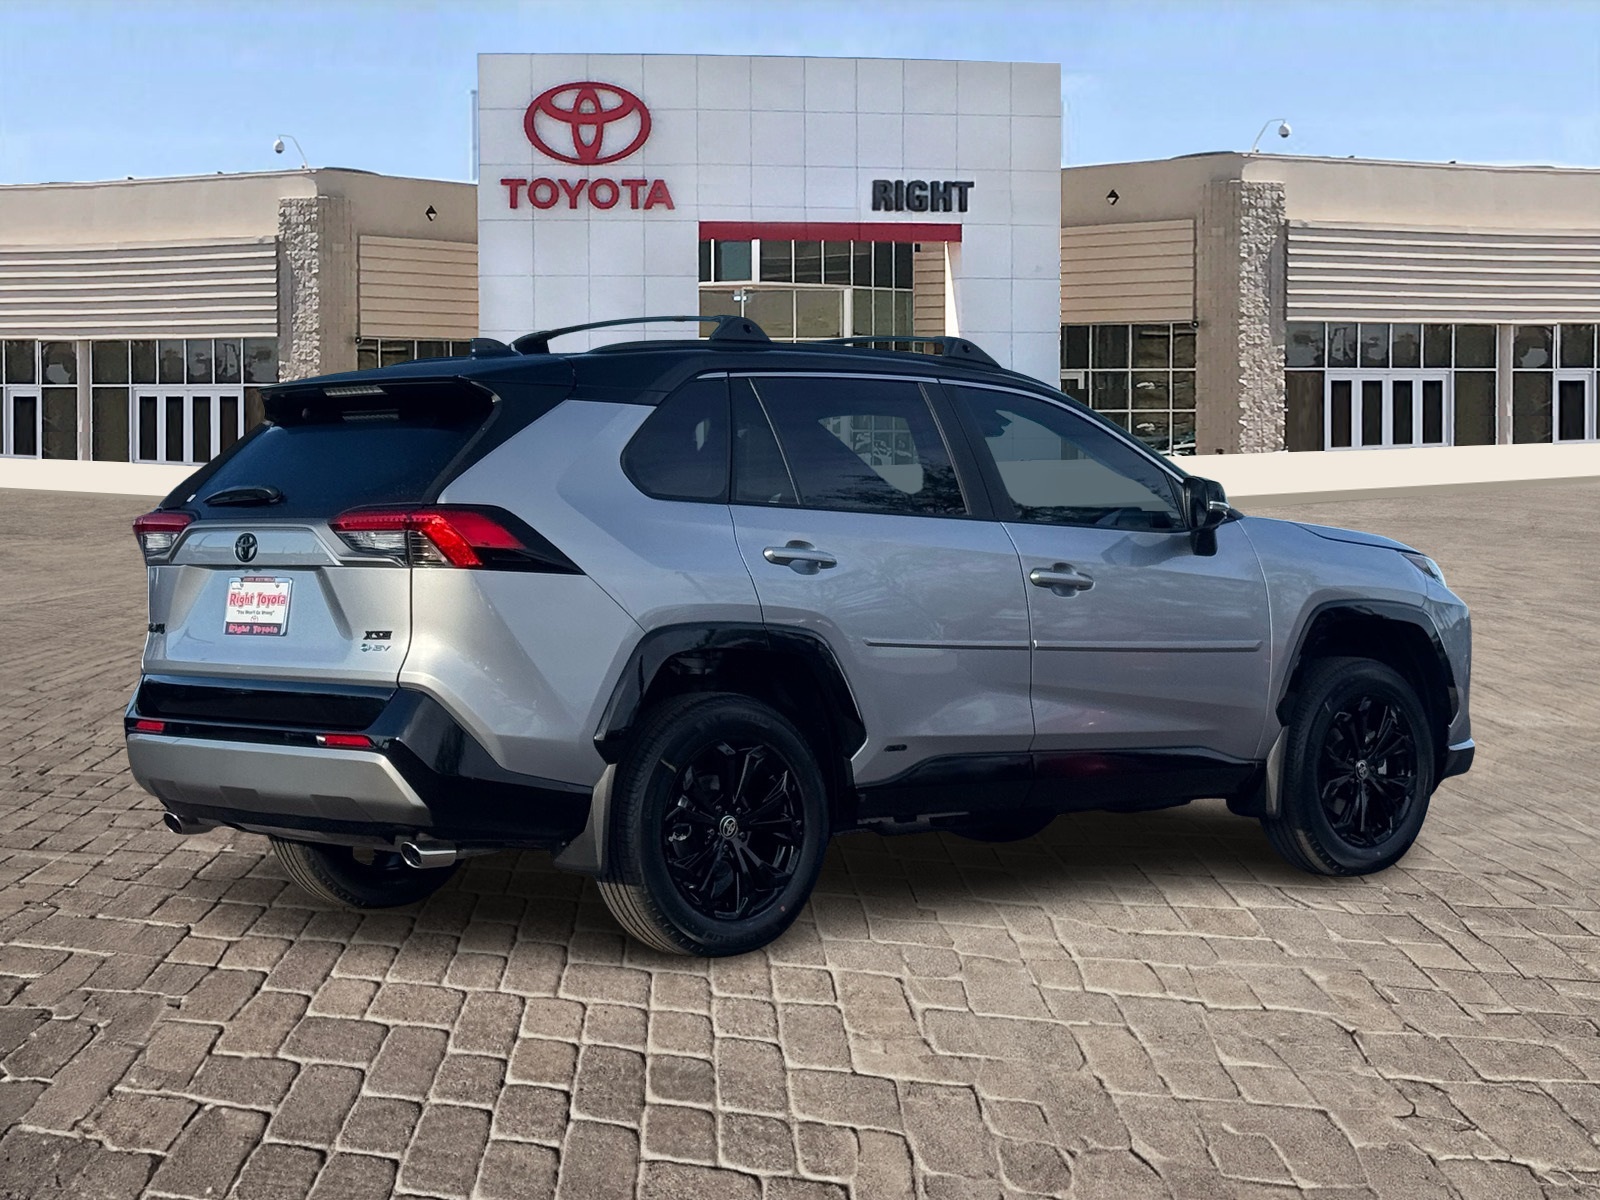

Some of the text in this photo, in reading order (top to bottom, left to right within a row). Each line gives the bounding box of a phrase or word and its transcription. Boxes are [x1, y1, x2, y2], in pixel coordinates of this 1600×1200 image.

[500, 178, 675, 210] TOYOTA
[872, 179, 975, 213] RIGHT
[229, 592, 287, 608] Right Toyota
[229, 624, 278, 634] Right Toyota
